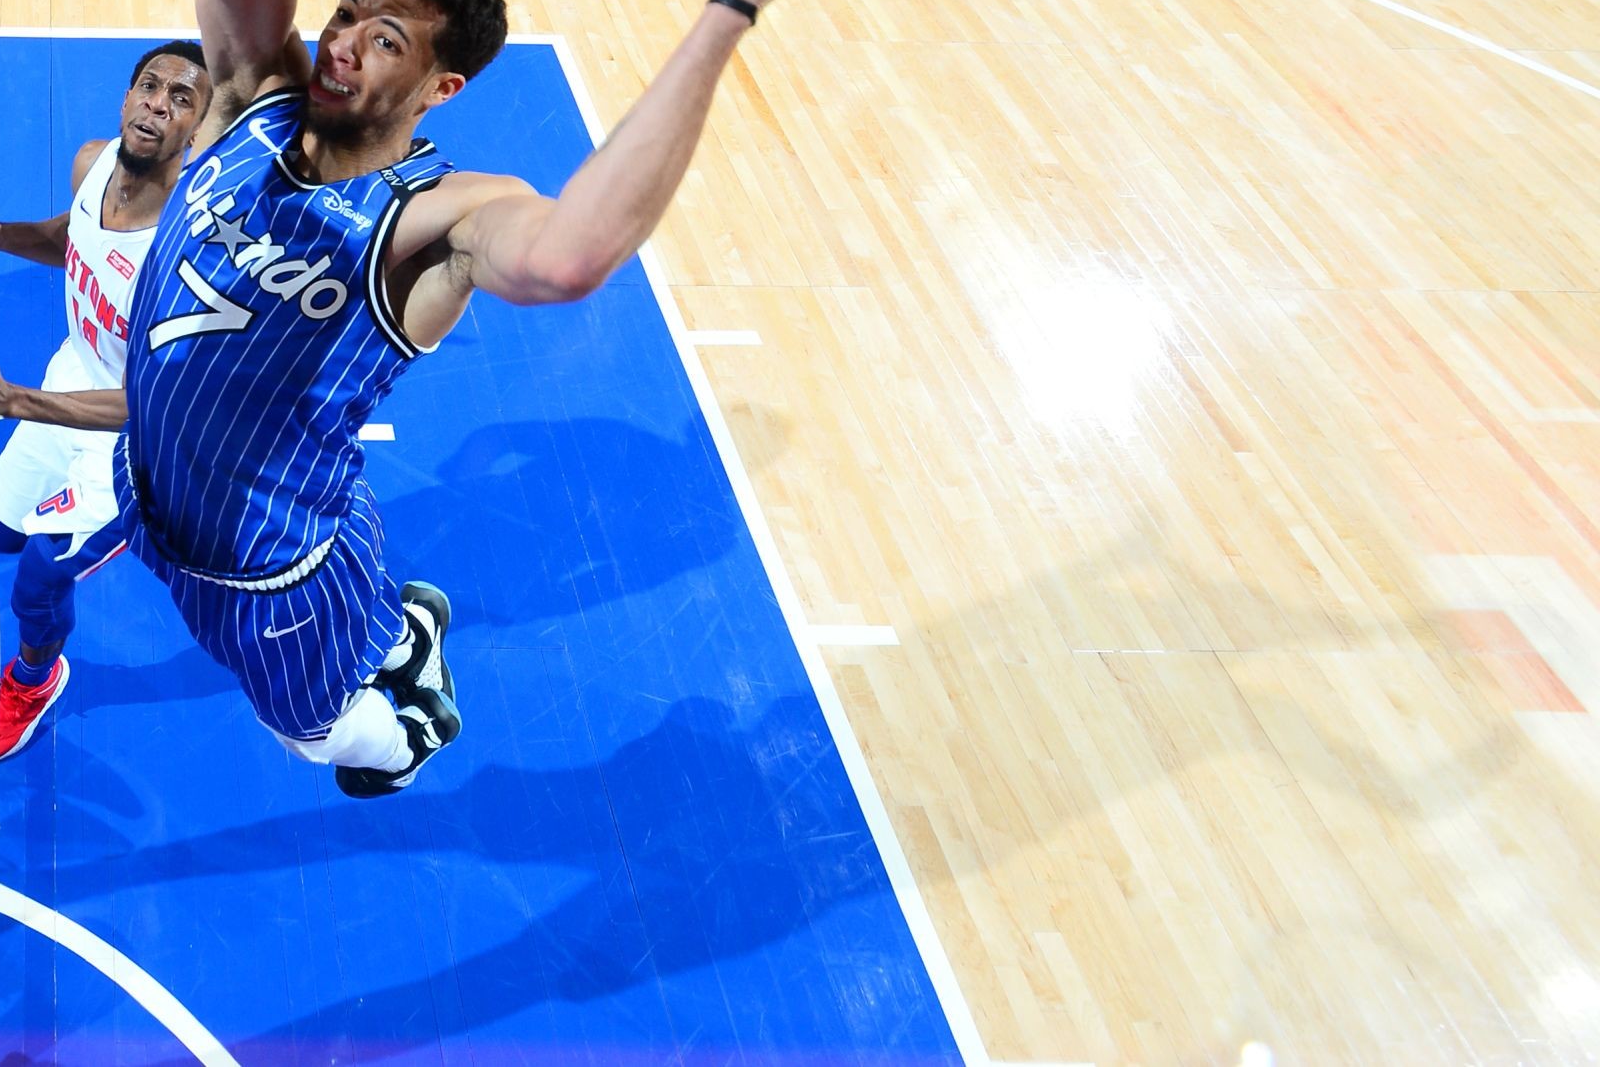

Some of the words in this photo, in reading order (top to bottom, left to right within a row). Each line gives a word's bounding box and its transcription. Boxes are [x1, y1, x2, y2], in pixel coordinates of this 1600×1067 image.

[186, 154, 348, 320] Orlando
[322, 186, 373, 233] Disney
[148, 258, 257, 353] 7
